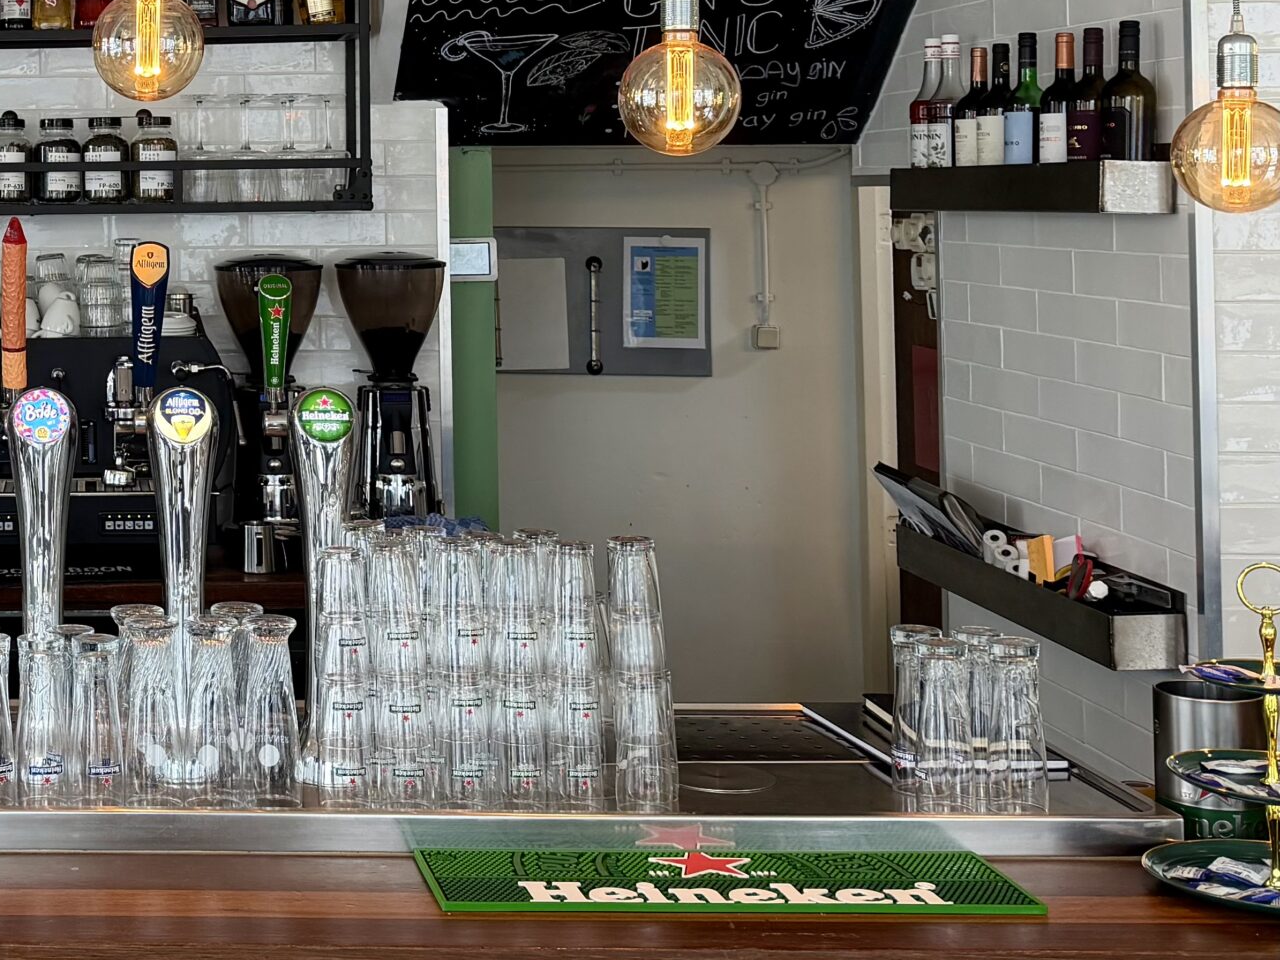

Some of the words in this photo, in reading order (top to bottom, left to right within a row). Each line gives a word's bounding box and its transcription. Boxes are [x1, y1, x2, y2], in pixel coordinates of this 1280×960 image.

[622, 11, 783, 58] TNIC
[135, 259, 165, 269] Affligem
[137, 305, 157, 366] Affligem
[271, 322, 280, 365] Heineken
[166, 399, 200, 408] Affligem
[25, 404, 58, 421] Bride
[302, 411, 350, 421] Heineken
[31, 766, 61, 774] Heineken
[91, 766, 119, 774] Heineken
[518, 881, 953, 905] Heineken
